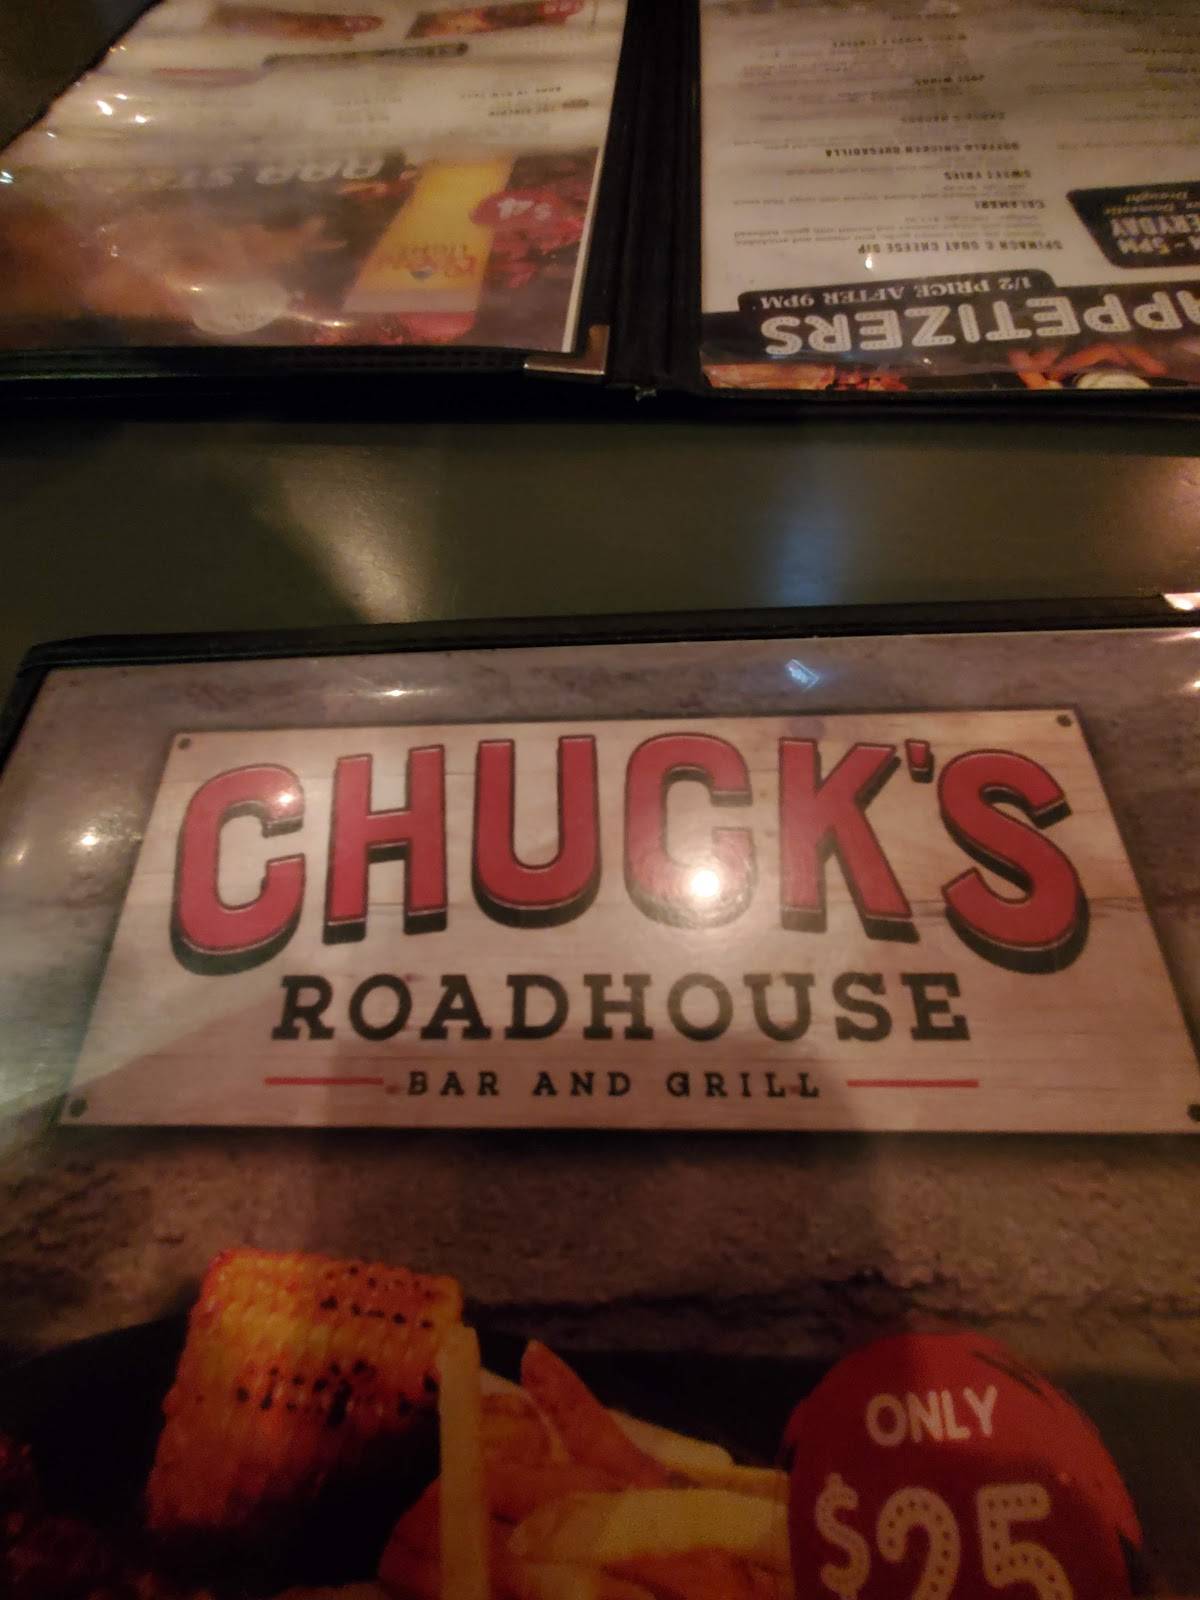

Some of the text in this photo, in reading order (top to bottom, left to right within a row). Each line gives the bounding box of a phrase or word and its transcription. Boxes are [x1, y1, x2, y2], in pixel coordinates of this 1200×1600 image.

[759, 275, 1034, 309] 1/2 PRICE AFTER 9PM
[170, 731, 1091, 975] CHUCK'S
[270, 971, 971, 1042] ROADHOUSE
[407, 1070, 820, 1099] BAR AND GRILL
[865, 1384, 997, 1448] ONLY
